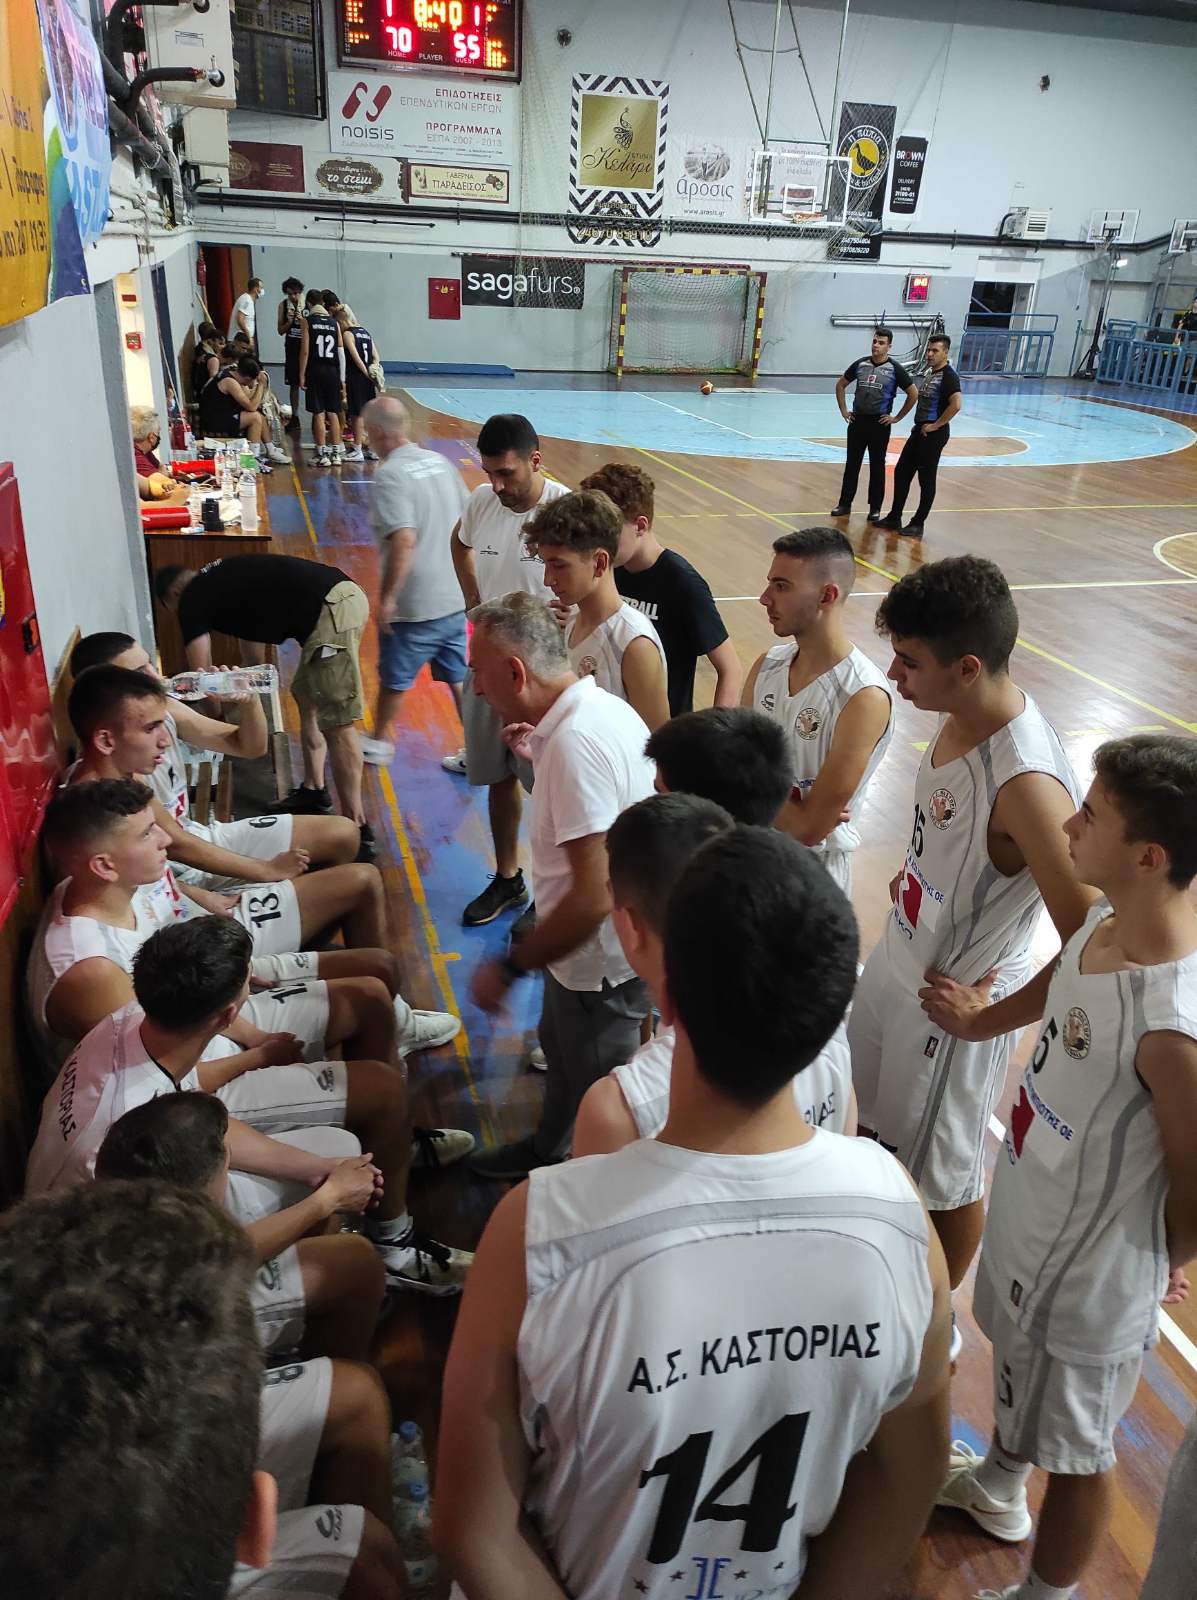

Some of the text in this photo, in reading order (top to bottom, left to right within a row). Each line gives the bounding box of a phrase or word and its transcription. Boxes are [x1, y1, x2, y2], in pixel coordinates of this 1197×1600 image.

[386, 26, 412, 53] 70
[418, 53, 443, 62] PLAYER
[435, 88, 502, 102] ΕΠΙΔΟΤΗΣΕΙΣ
[341, 125, 395, 141] noisis
[425, 122, 502, 136] ΠΡΟΓΡΑΜΜΑΤΑ
[896, 150, 925, 162] BROWN
[432, 179, 487, 192] ΠΑΡΑΔΕΙΣΟΣ
[316, 334, 335, 358] 12
[251, 892, 282, 929] 13
[627, 1322, 881, 1395] Α.Σ. ΚΑΣΤΟΡΙΑΣ
[638, 1410, 811, 1565] 14
